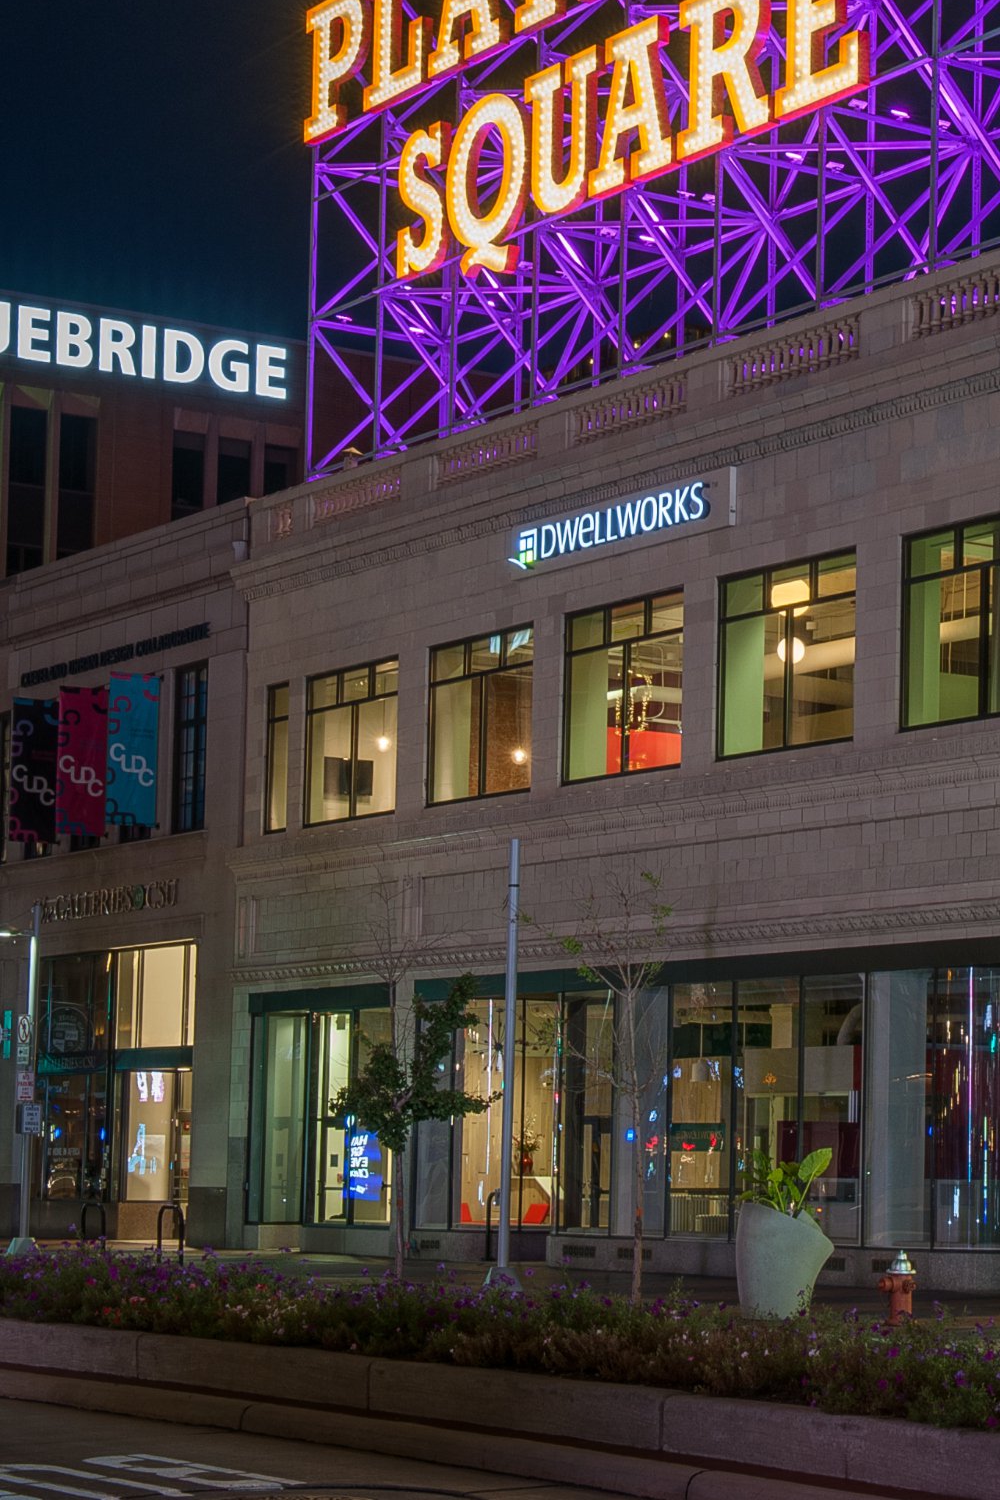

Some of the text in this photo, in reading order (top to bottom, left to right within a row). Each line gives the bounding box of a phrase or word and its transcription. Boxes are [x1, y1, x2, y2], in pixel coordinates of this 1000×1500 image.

[0, 301, 287, 399] EBRIDGE
[54, 885, 132, 921] GALLERIES
[144, 878, 178, 909] CSU
